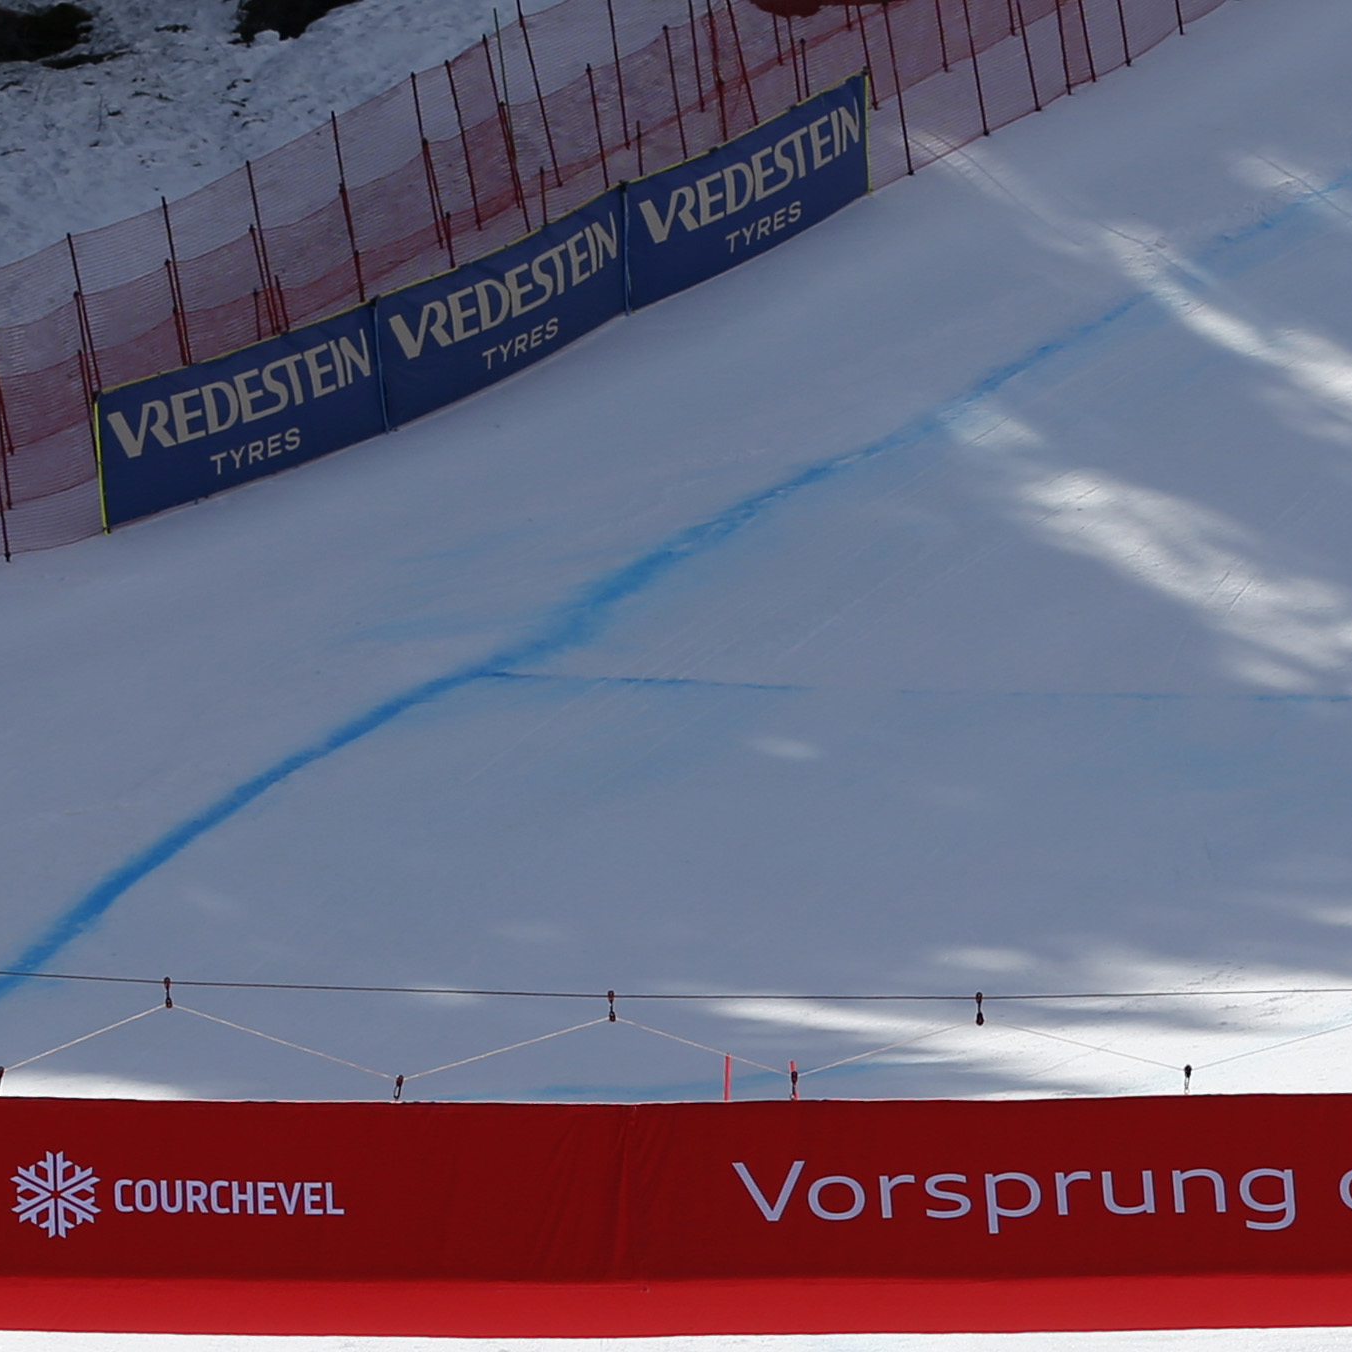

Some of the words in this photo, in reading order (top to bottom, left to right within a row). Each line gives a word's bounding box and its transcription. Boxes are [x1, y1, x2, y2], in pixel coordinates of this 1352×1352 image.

[639, 106, 861, 243] VREDESTEIN
[725, 200, 802, 254] TYRES
[389, 211, 618, 360] VREDESTEIN
[482, 317, 559, 371] TYRES
[107, 328, 372, 459] VREDESTEIN
[209, 427, 301, 475] TYRES
[114, 1178, 344, 1215] COURCHEVEL
[732, 1160, 1296, 1233] Vorsprung
